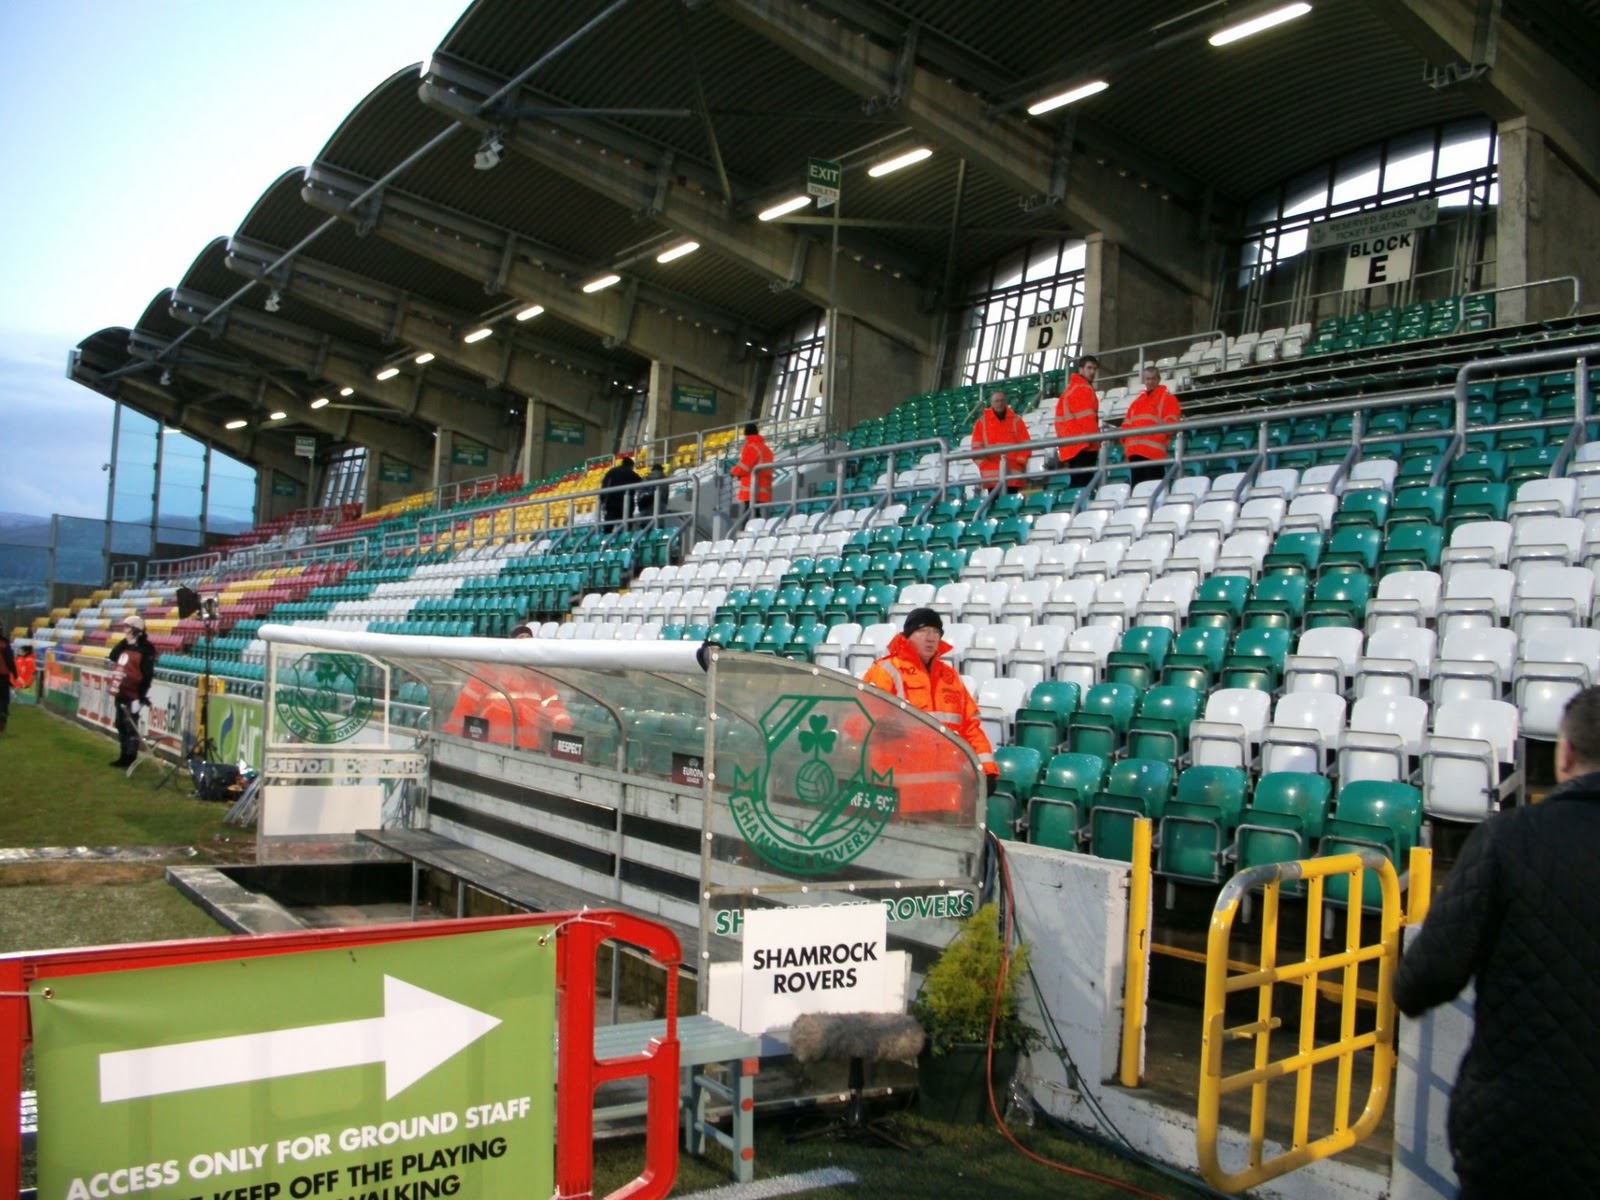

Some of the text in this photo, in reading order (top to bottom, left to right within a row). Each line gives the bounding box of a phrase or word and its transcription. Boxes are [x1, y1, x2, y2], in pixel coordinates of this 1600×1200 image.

[810, 165, 839, 182] EXIT
[1330, 207, 1416, 232] RESERVED SEASON
[1336, 219, 1408, 240] TICKET SEATING
[1350, 233, 1411, 258] BLOCK
[1368, 254, 1389, 284] E
[1028, 309, 1068, 328] BLOCK
[1037, 326, 1054, 350] D
[557, 740, 583, 755] RESPECT
[812, 826, 871, 866] ROVERS
[883, 892, 974, 921] ROVERS
[753, 942, 878, 970] SHAMROCK
[773, 968, 858, 994] ROVERS
[66, 1096, 531, 1200] ACCESS ONLY FOR GROUND STAFF
[289, 1169, 339, 1199] OFF
[347, 1159, 393, 1187] THE
[402, 1137, 508, 1176] PLAYING
